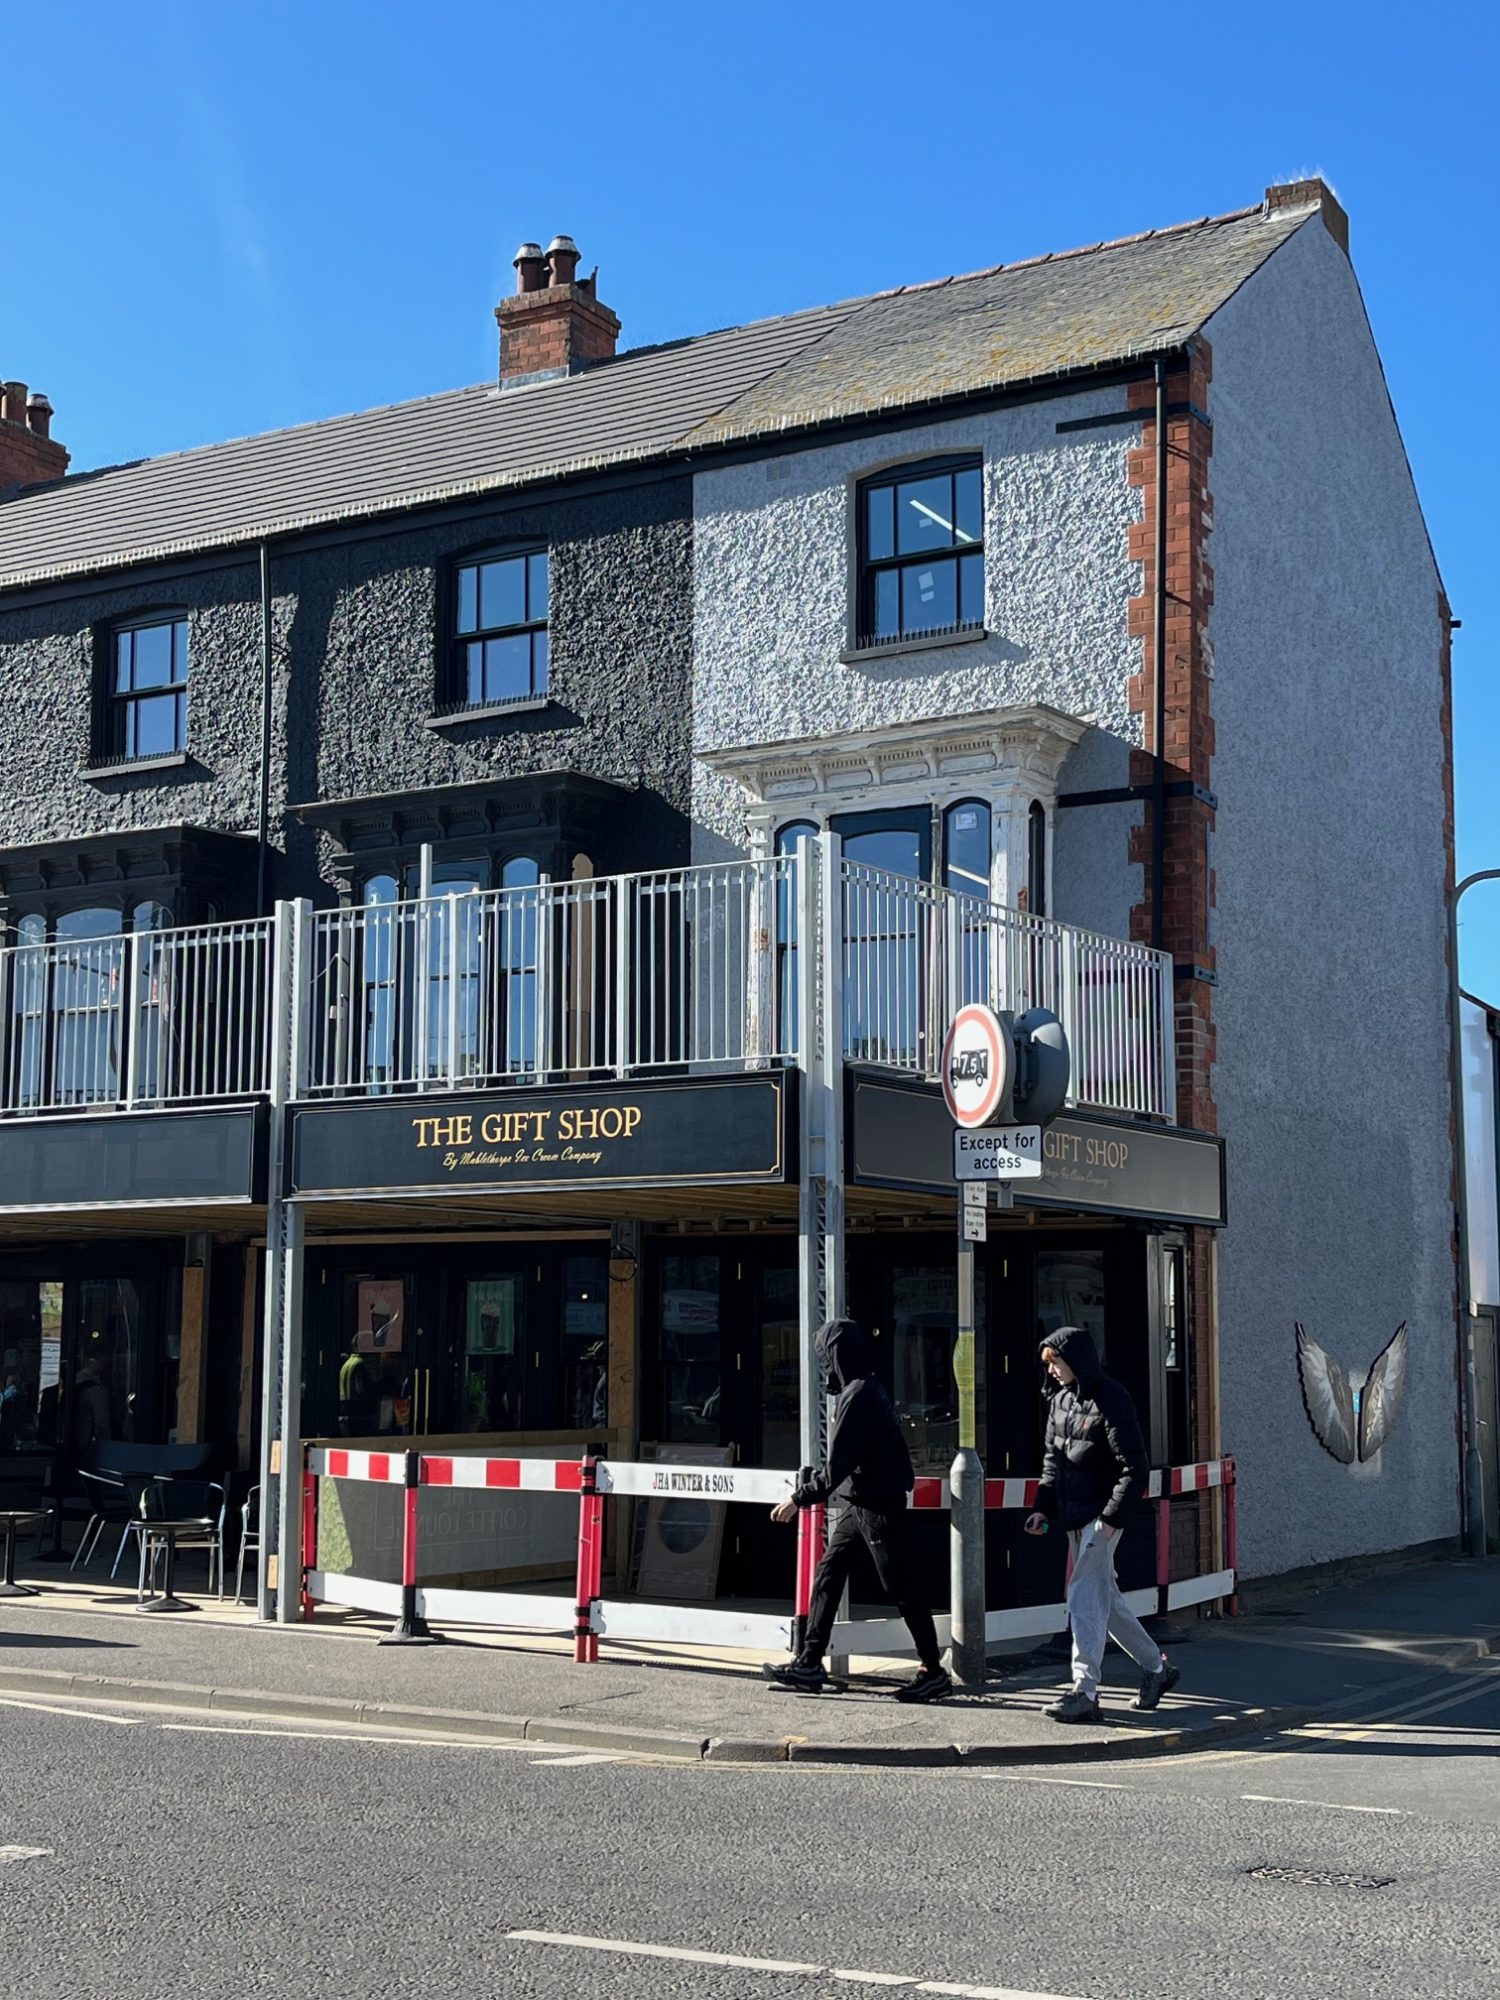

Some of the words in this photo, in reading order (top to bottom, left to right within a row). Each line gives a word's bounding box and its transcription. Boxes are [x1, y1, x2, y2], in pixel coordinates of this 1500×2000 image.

[412, 1115, 473, 1148] THE
[481, 1110, 551, 1143] GIFT
[558, 1106, 642, 1140] SHOP
[960, 1133, 1008, 1152] Except
[1015, 1132, 1035, 1147] for
[1043, 1130, 1082, 1162] GIFT
[1086, 1137, 1128, 1168] SHOP
[442, 1152, 458, 1171] By
[459, 1150, 513, 1168] Mablethorpe
[531, 1147, 559, 1162] Cream
[560, 1146, 603, 1165] Company
[974, 1156, 1022, 1169] access
[671, 1473, 703, 1491] WINTER
[705, 1475, 711, 1492] &
[712, 1475, 734, 1493] SONS
